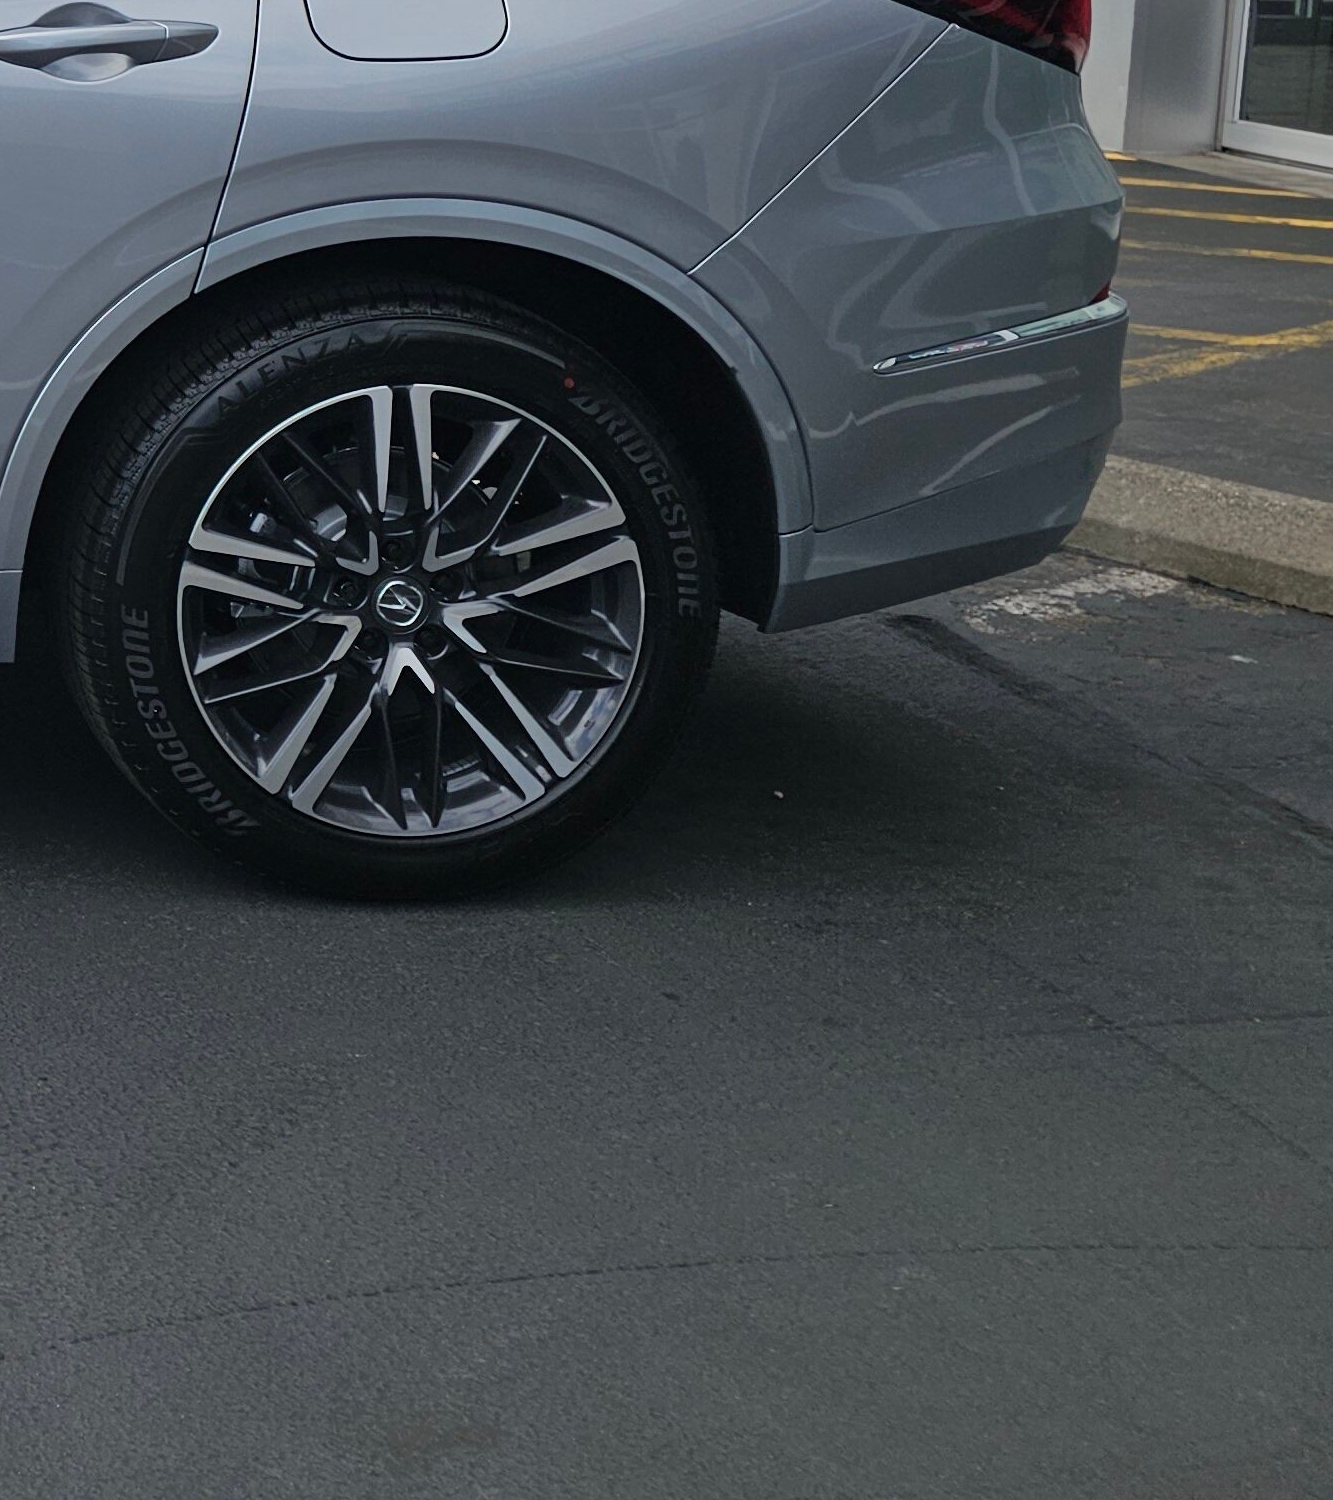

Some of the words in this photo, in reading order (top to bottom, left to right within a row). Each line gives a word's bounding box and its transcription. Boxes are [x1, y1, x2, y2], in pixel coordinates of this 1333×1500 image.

[212, 331, 366, 418] ALENZA
[572, 386, 702, 621] BRIDGESTONE
[119, 602, 261, 838] BRIDGESTONE
